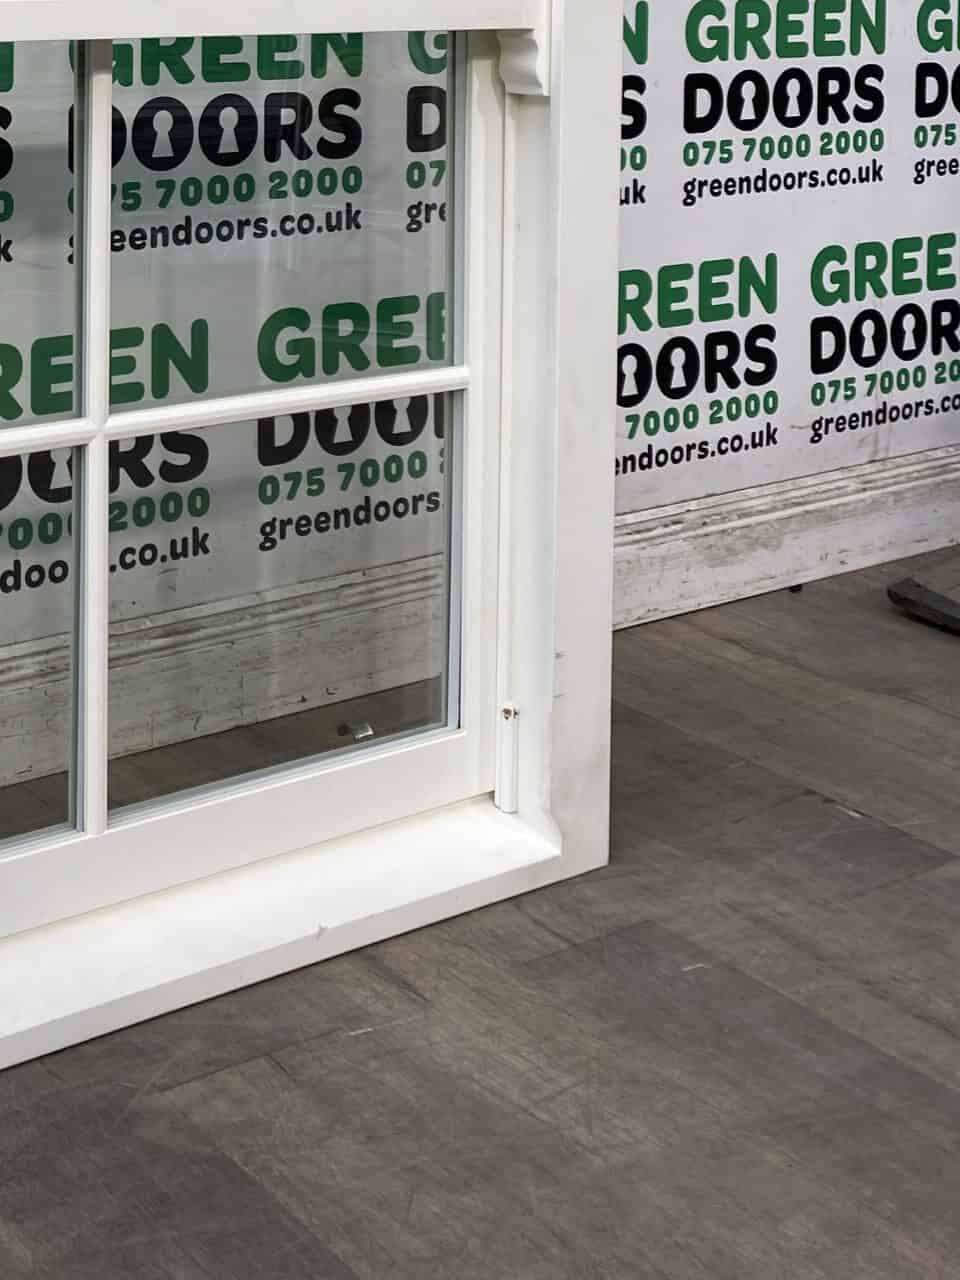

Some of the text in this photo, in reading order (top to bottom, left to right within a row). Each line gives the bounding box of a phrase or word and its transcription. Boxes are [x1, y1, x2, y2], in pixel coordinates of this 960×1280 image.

[682, 64, 884, 133] DOORS
[682, 127, 884, 166] 075 7000 2000
[914, 124, 956, 147] 075
[155, 173, 256, 208] 7000
[268, 166, 362, 199] 2000
[681, 158, 884, 206] greendoors.co.uk
[68, 203, 361, 264] eendoors.co.uk
[810, 376, 857, 407] 075
[864, 370, 926, 396] 7000
[257, 394, 444, 467] DOO
[626, 389, 779, 440] 7000 2000
[257, 468, 325, 505] 075
[337, 450, 428, 489] 7000
[108, 487, 210, 532] 2000
[258, 491, 440, 551] greendoors
